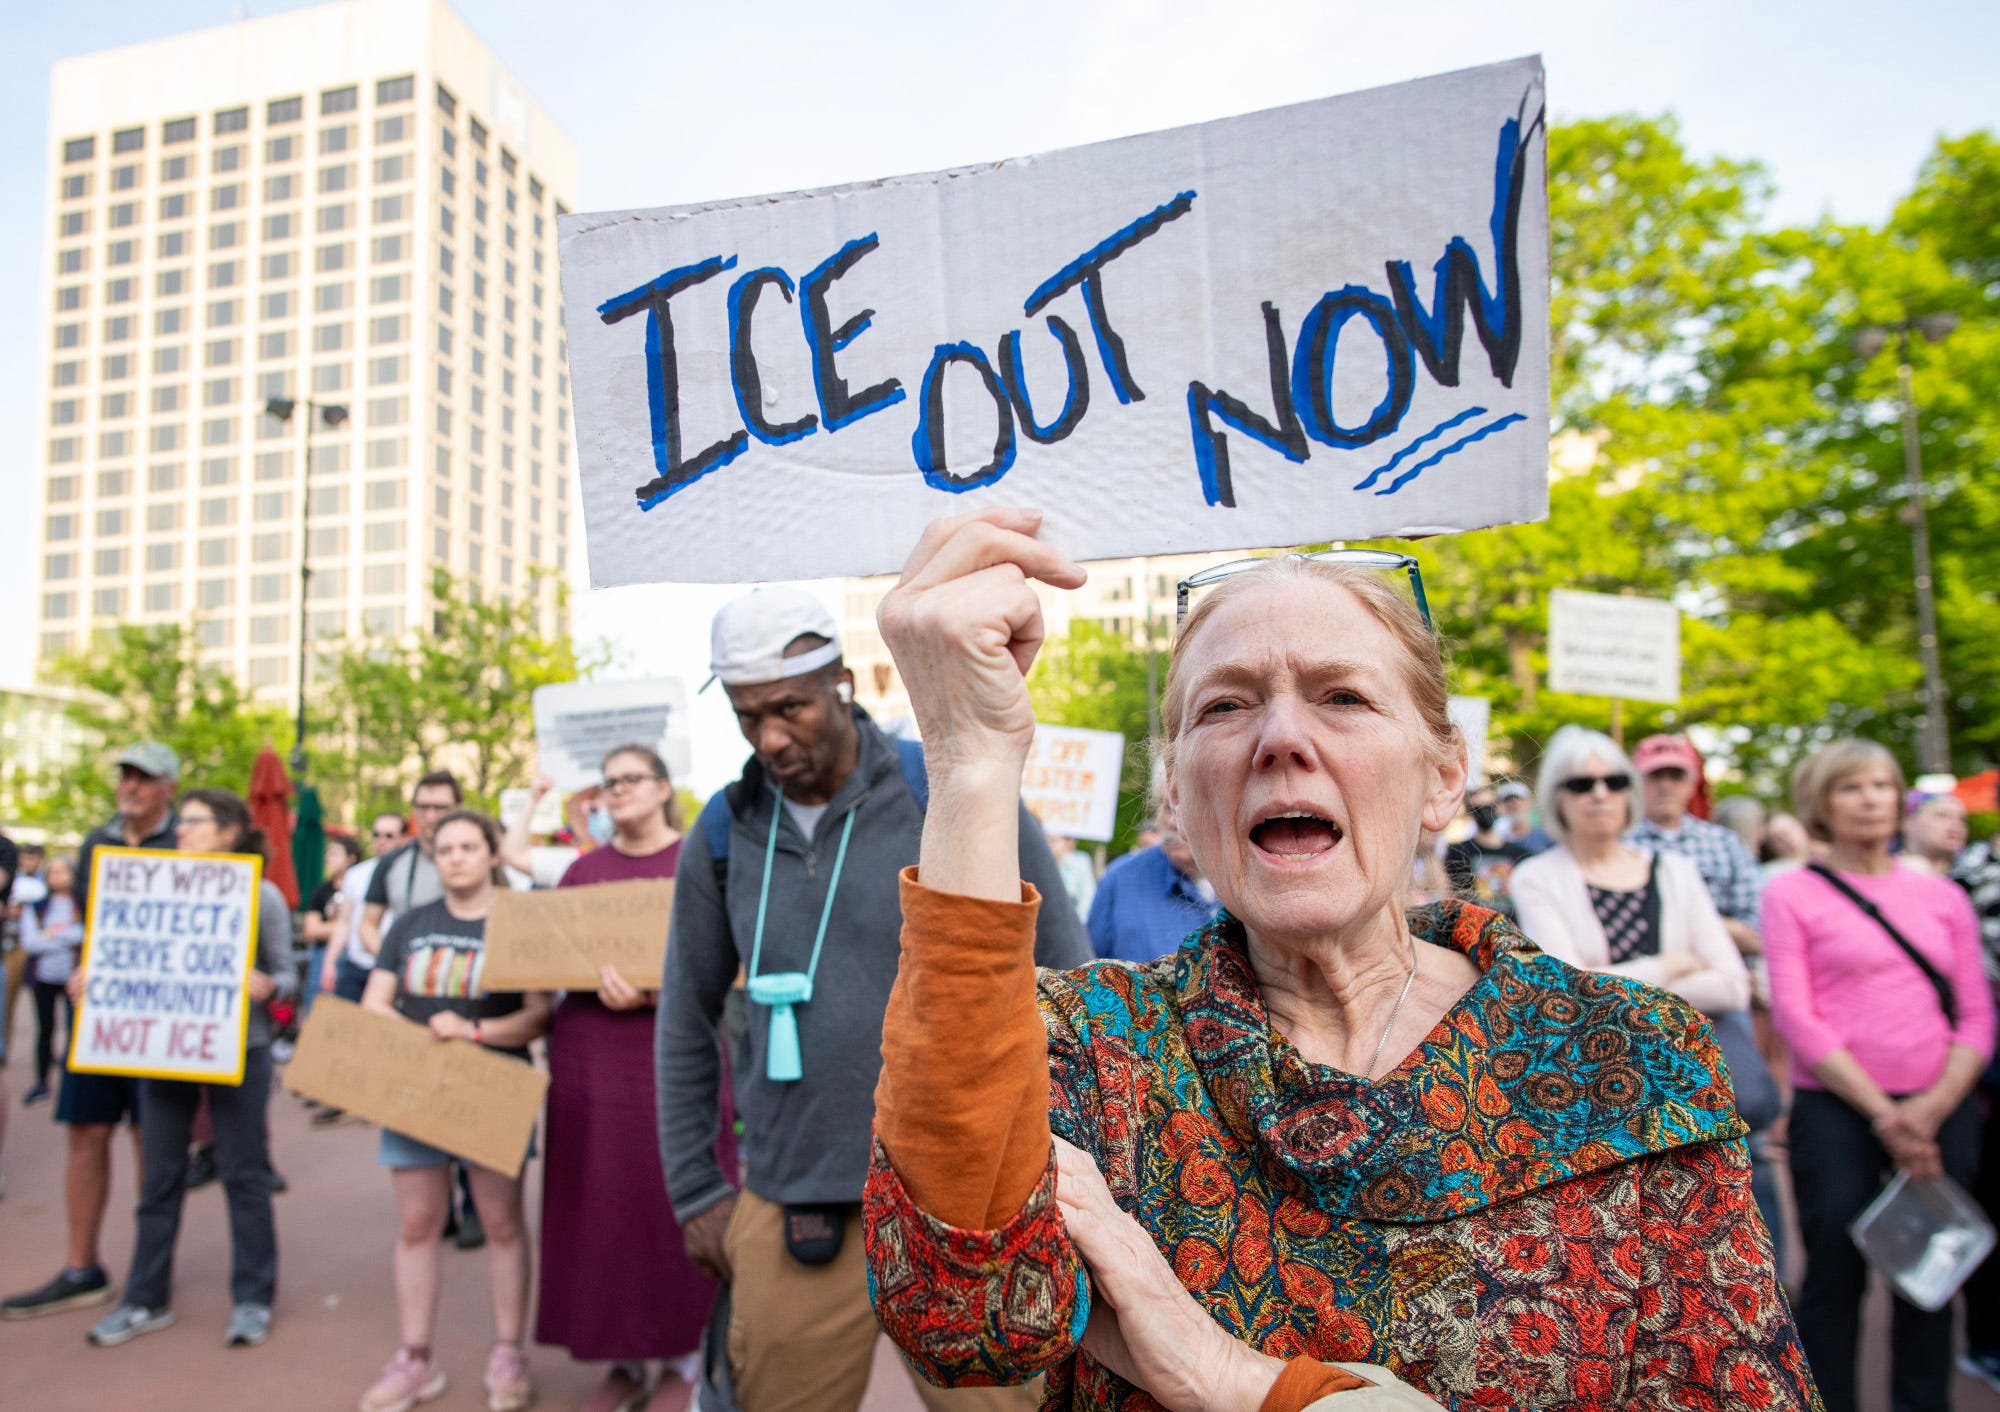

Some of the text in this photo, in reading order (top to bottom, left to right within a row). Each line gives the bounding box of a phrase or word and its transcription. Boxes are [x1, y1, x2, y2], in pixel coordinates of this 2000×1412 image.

[597, 85, 1545, 512] ICE OUT NOW
[105, 859, 247, 897] HEY WPD:
[99, 898, 228, 937] PROTECT
[94, 935, 236, 976] SERVE OUR
[86, 975, 240, 1019] COMMUNITY
[91, 1016, 219, 1061] NOT ICE
